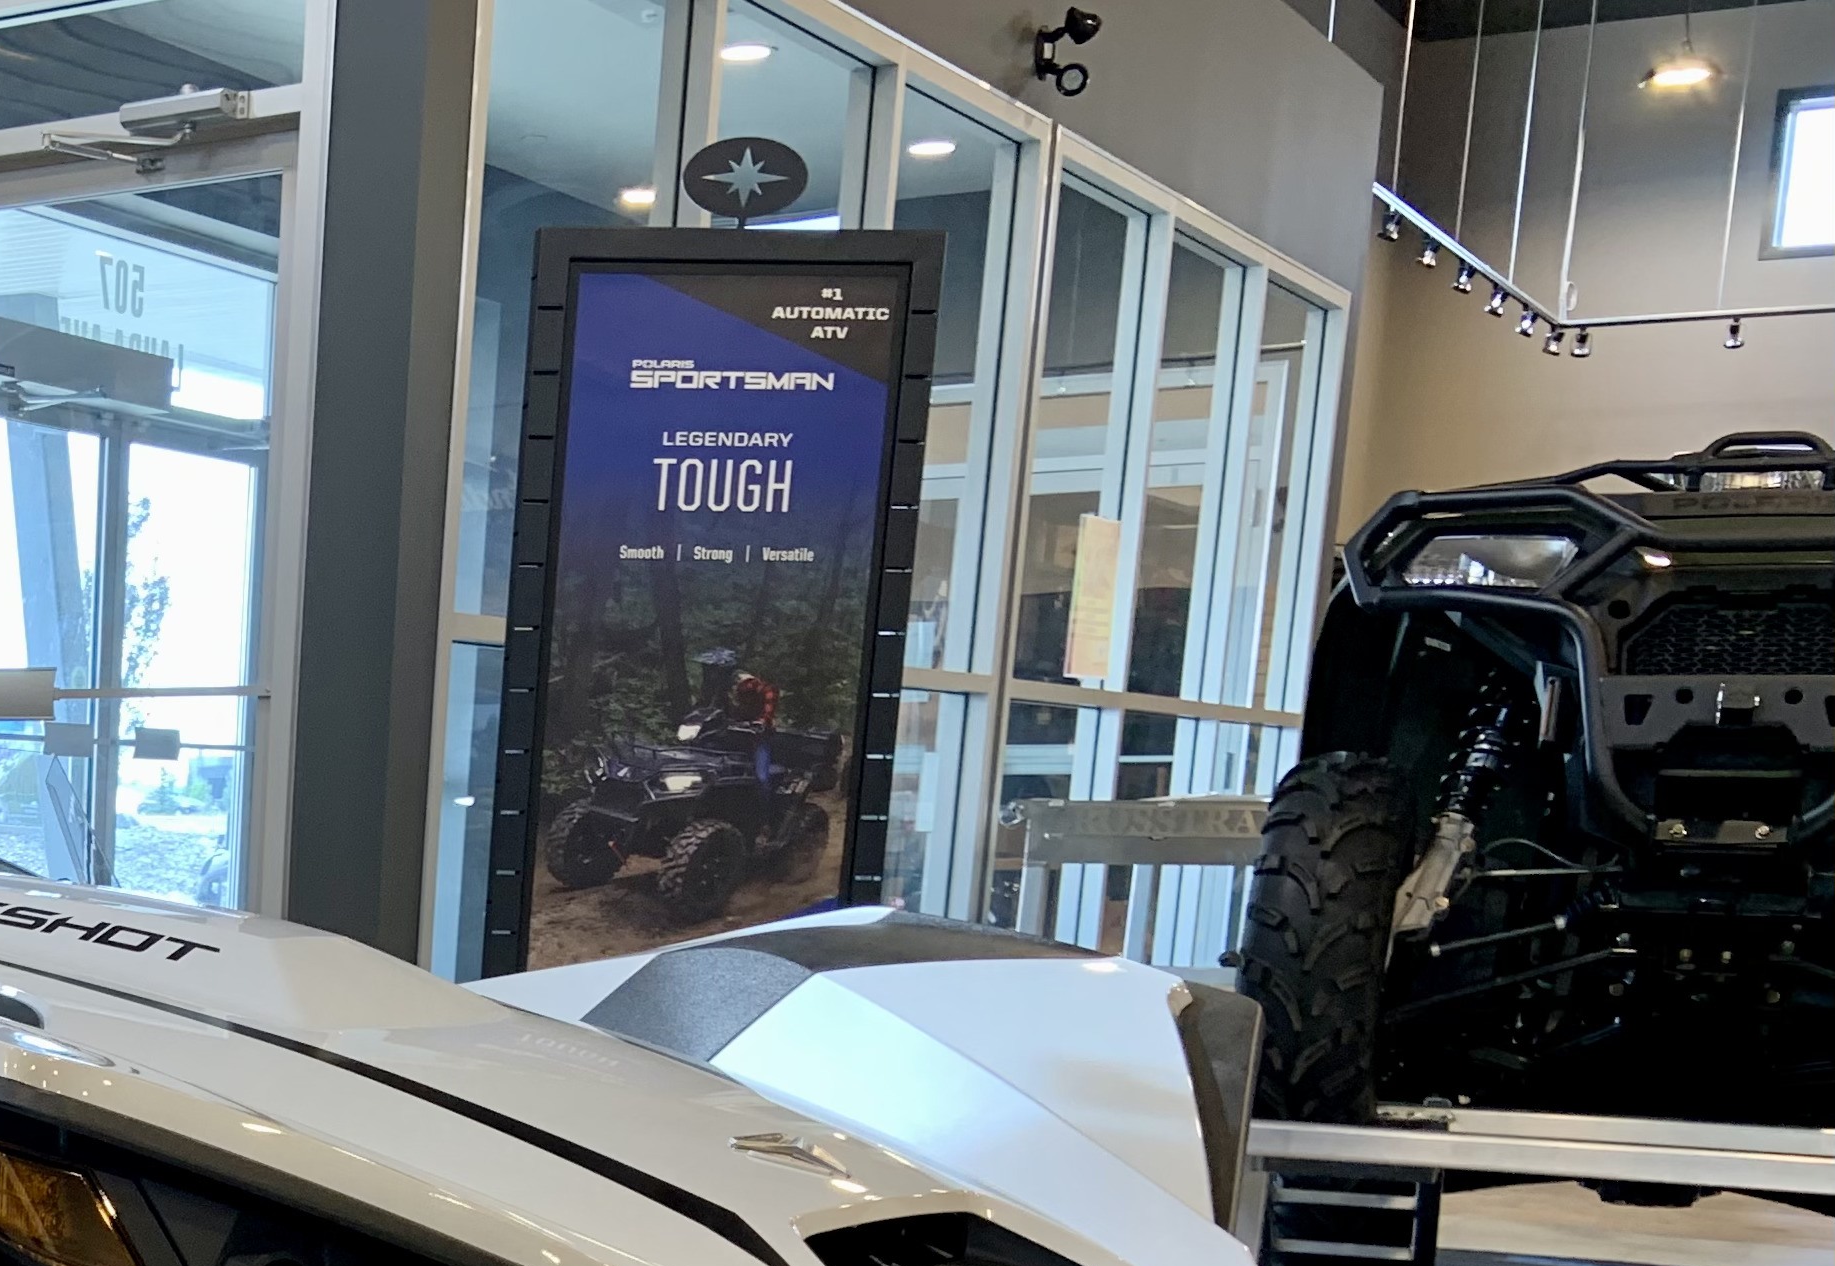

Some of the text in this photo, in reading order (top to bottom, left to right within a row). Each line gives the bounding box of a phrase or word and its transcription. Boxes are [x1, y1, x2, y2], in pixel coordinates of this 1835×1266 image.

[821, 288, 844, 301] #1
[771, 306, 891, 321] AUTOMATIC
[810, 325, 849, 340] ATV
[631, 359, 695, 369] POLARIS
[629, 370, 835, 391] SPORTSMAN
[662, 431, 794, 448] LEGENDARY
[653, 457, 794, 513] TOUGH
[619, 545, 814, 564] Smooth Strong Versatile
